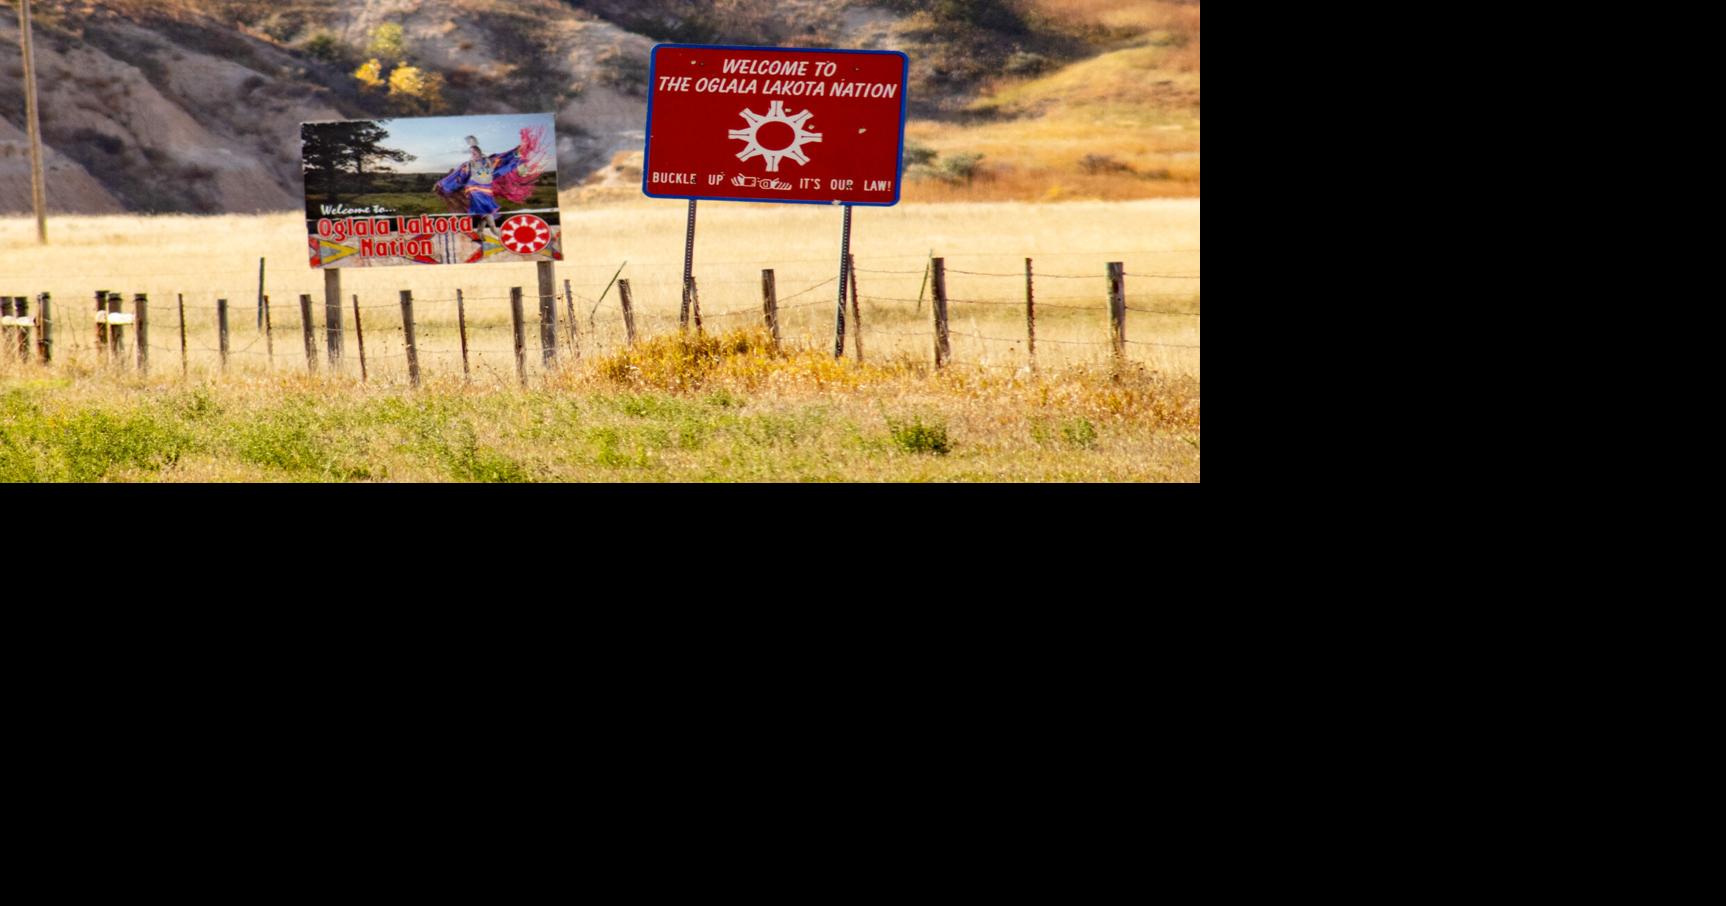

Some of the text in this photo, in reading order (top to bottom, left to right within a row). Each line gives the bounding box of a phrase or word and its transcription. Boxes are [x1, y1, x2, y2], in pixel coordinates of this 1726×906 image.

[722, 59, 837, 77] WELCOME TO
[659, 76, 897, 98] THE OGLALA LAKOTA NATION
[652, 172, 892, 192] BUCKLE UP IT'S OUR LAW!
[320, 204, 370, 215] Welcome
[317, 214, 473, 242] Oglala Lakota
[360, 238, 433, 257] Nation
